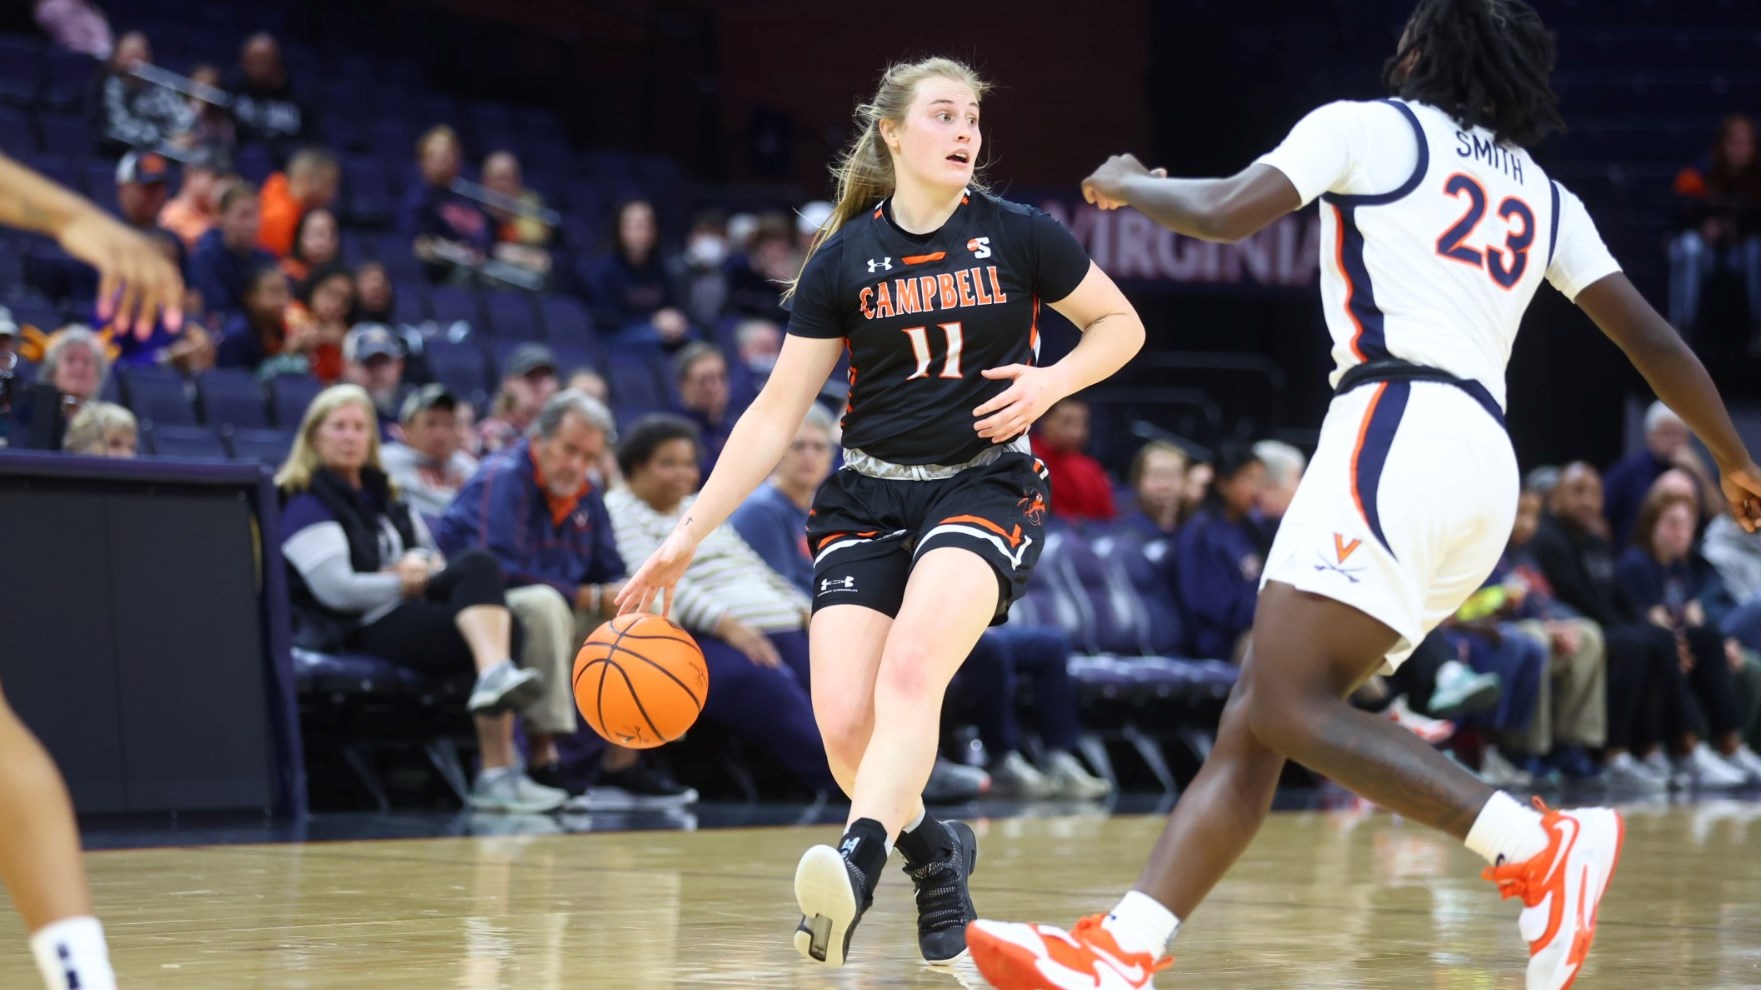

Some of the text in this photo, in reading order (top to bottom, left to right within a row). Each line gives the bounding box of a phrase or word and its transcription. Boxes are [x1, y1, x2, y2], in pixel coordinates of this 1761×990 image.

[1456, 130, 1523, 185] SMITH
[1435, 171, 1535, 292] 23
[859, 265, 1007, 319] CAMPBELL
[901, 321, 964, 381] 11
